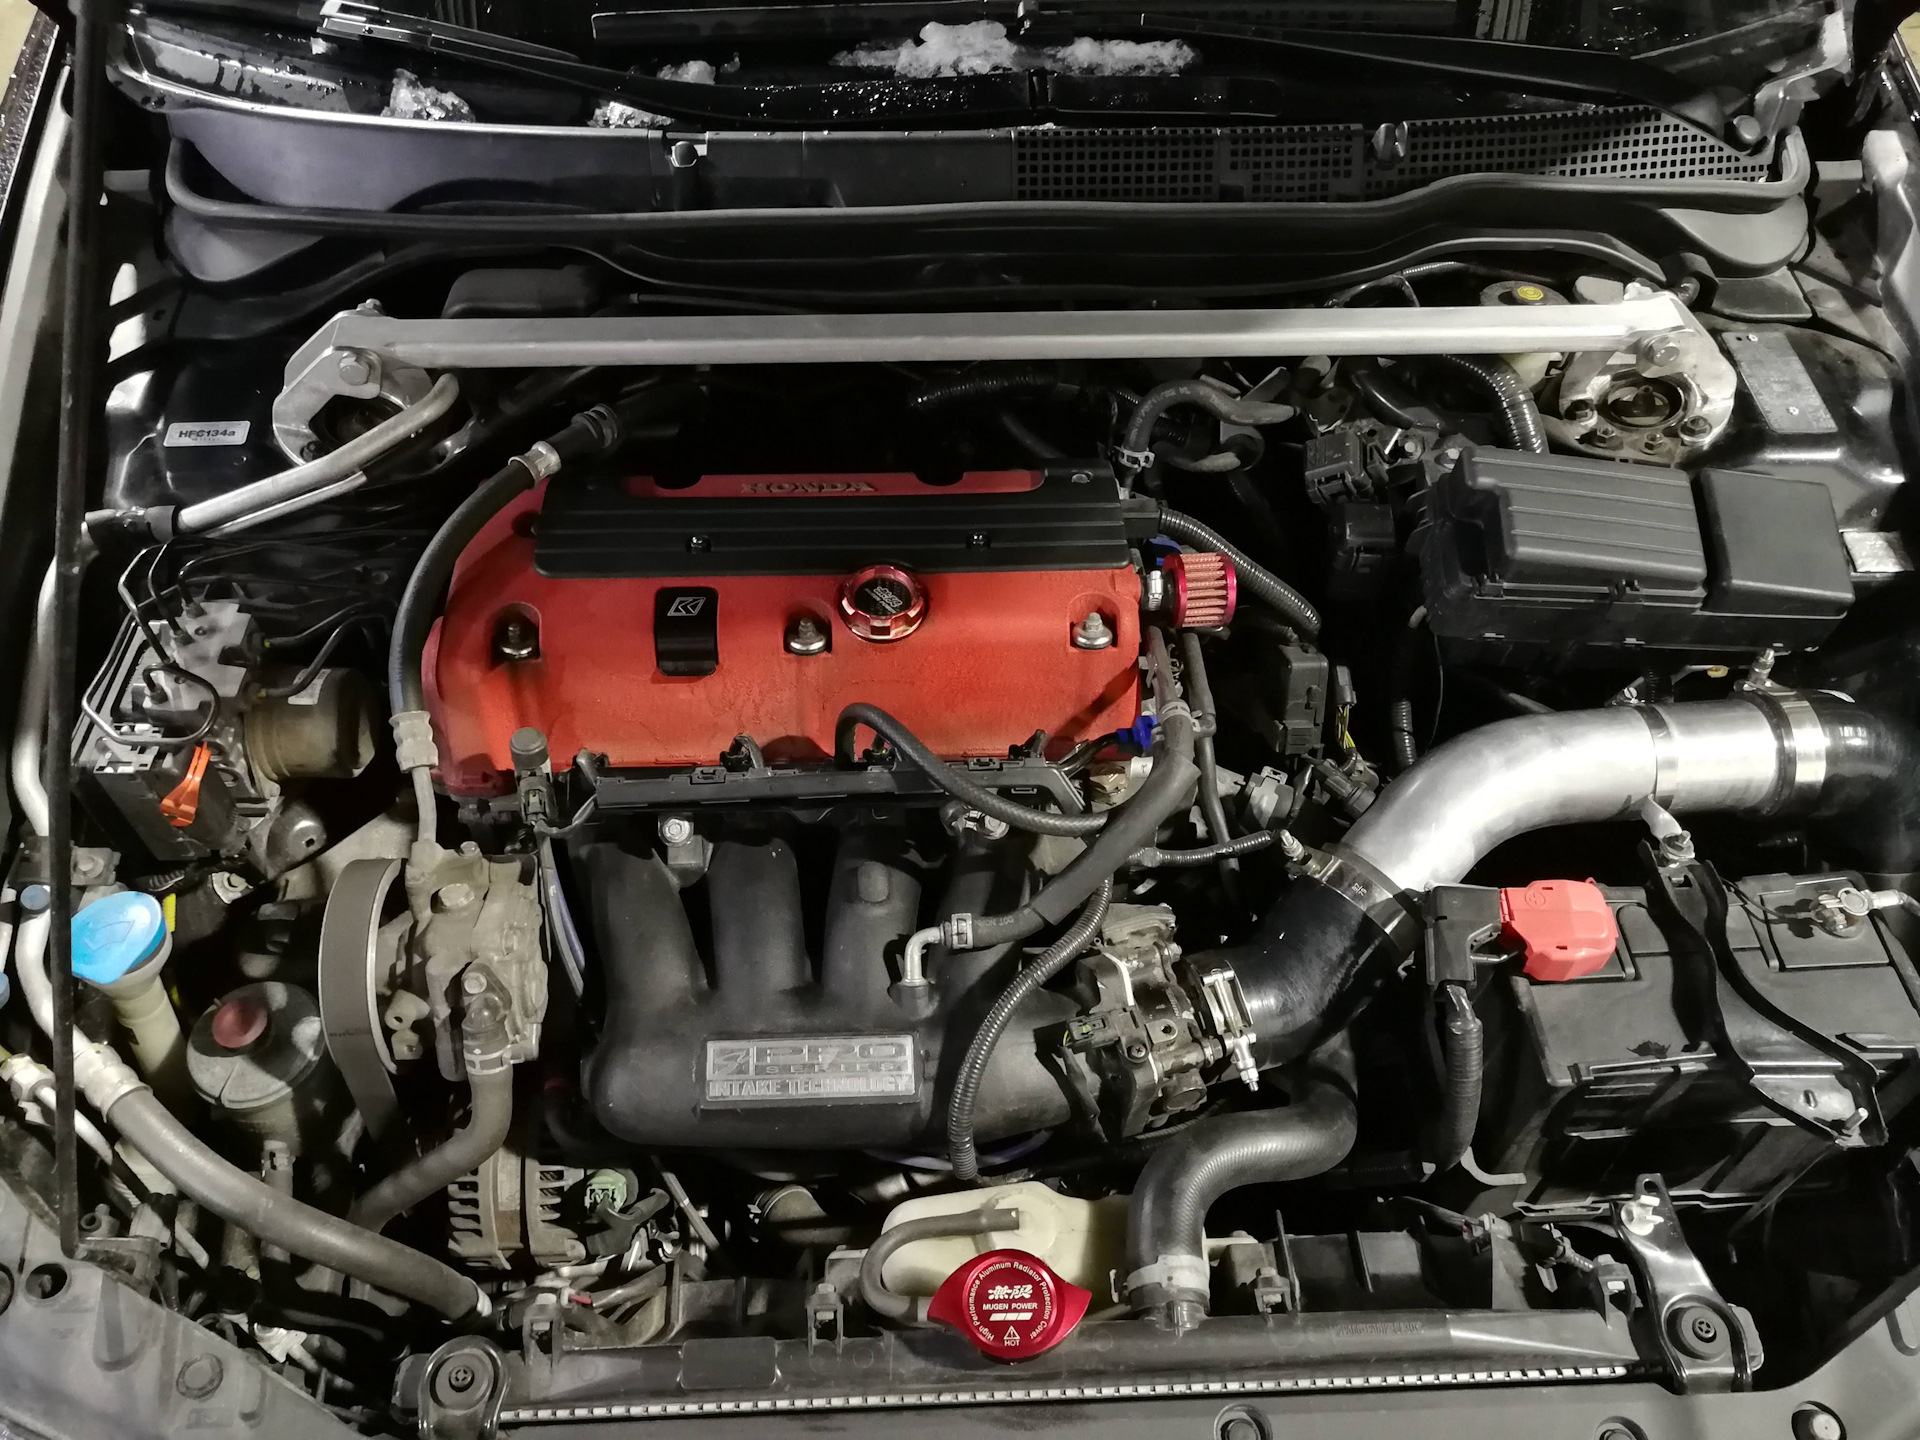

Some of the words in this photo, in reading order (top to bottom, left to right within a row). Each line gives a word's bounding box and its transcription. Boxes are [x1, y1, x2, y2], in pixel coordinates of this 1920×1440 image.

[178, 429, 236, 438] HFC134a
[741, 482, 876, 494] HONDA
[766, 1063, 894, 1074] SERIES
[709, 1079, 782, 1096] INTAKE
[786, 1076, 910, 1095] TECHNOLOGY
[978, 1262, 1012, 1280] Aluminum
[1013, 1261, 1042, 1281] Radiator
[968, 1279, 981, 1326] Performance
[982, 1303, 1009, 1311] MUGEN
[1011, 1302, 1038, 1310] POWER
[1039, 1281, 1052, 1320] Protection
[978, 1325, 995, 1341] High
[1030, 1320, 1048, 1339] Cover
